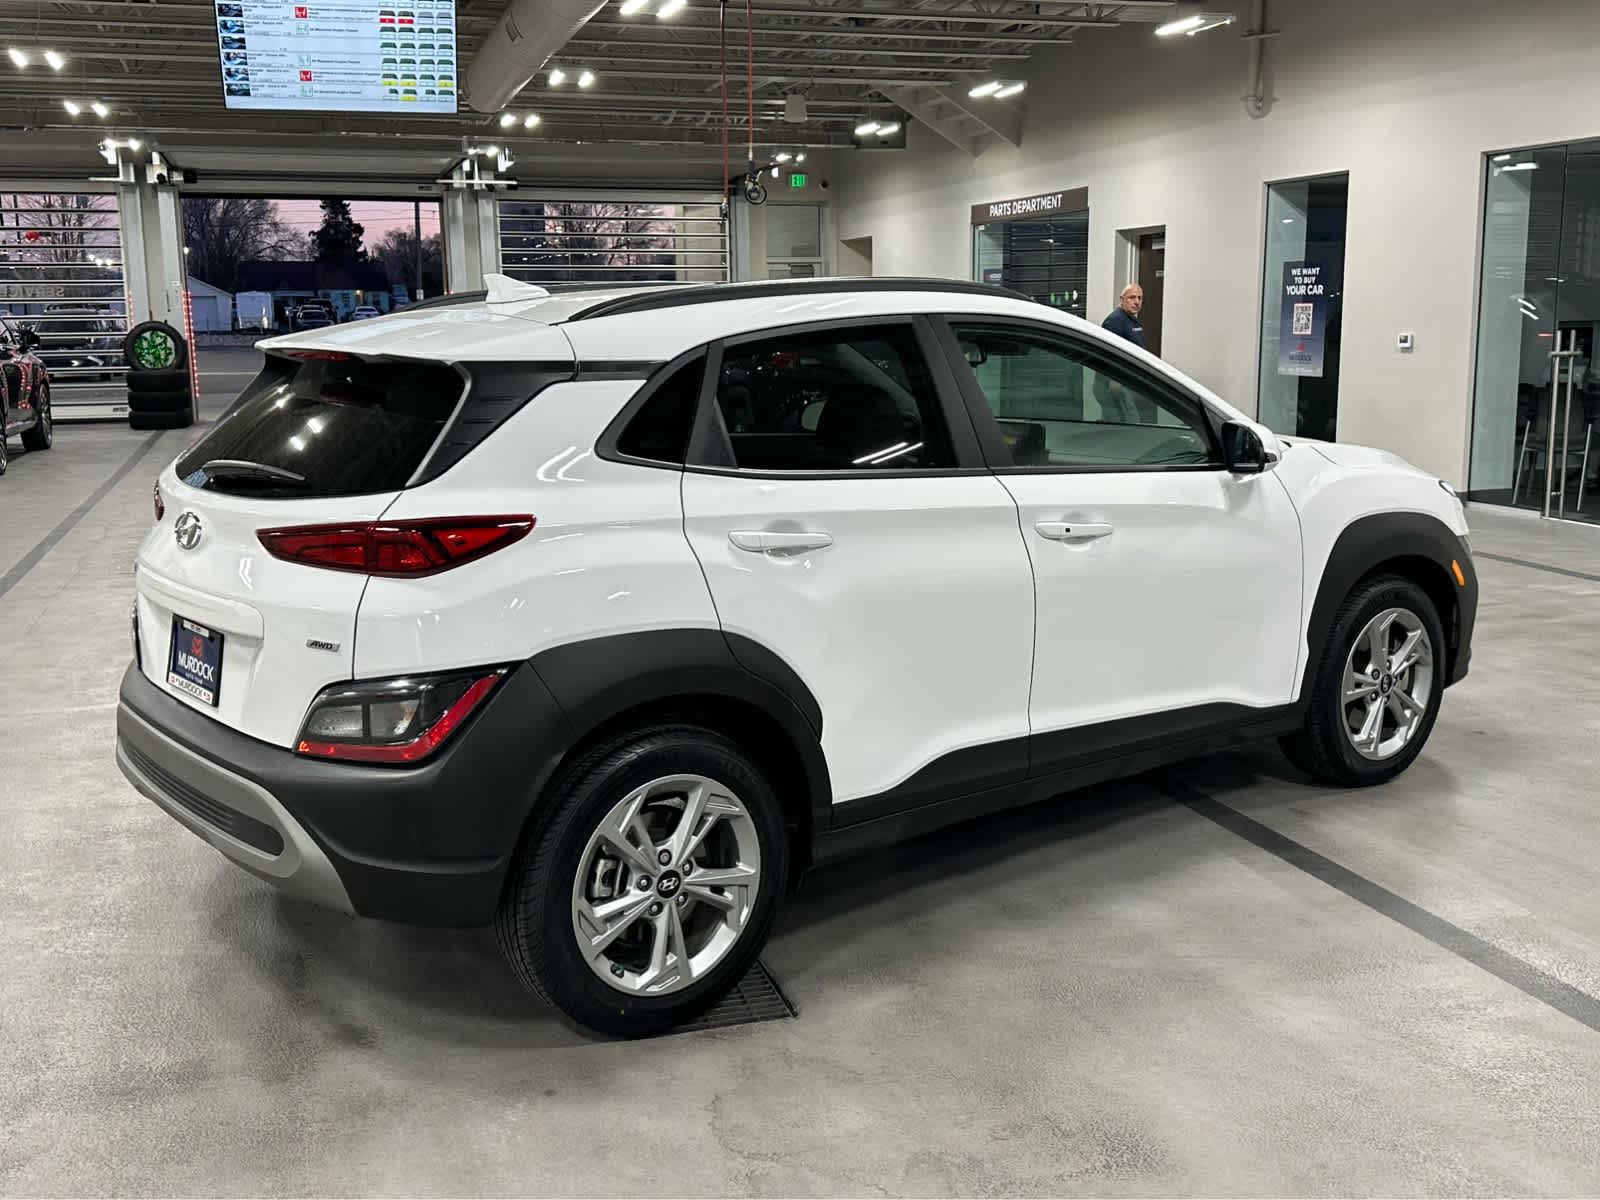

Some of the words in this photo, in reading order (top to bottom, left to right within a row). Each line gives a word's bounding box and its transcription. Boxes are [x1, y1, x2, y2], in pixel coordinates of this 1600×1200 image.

[989, 202, 1011, 216] PARTS
[1012, 194, 1063, 214] DEPARTMENT
[1302, 267, 1320, 275] WANT
[1294, 276, 1302, 284] TO
[1303, 276, 1316, 284] BUY
[1286, 285, 1306, 295] YOUR
[1307, 284, 1324, 295] CAR
[310, 640, 333, 650] AWD
[178, 651, 214, 681] MURDOCK
